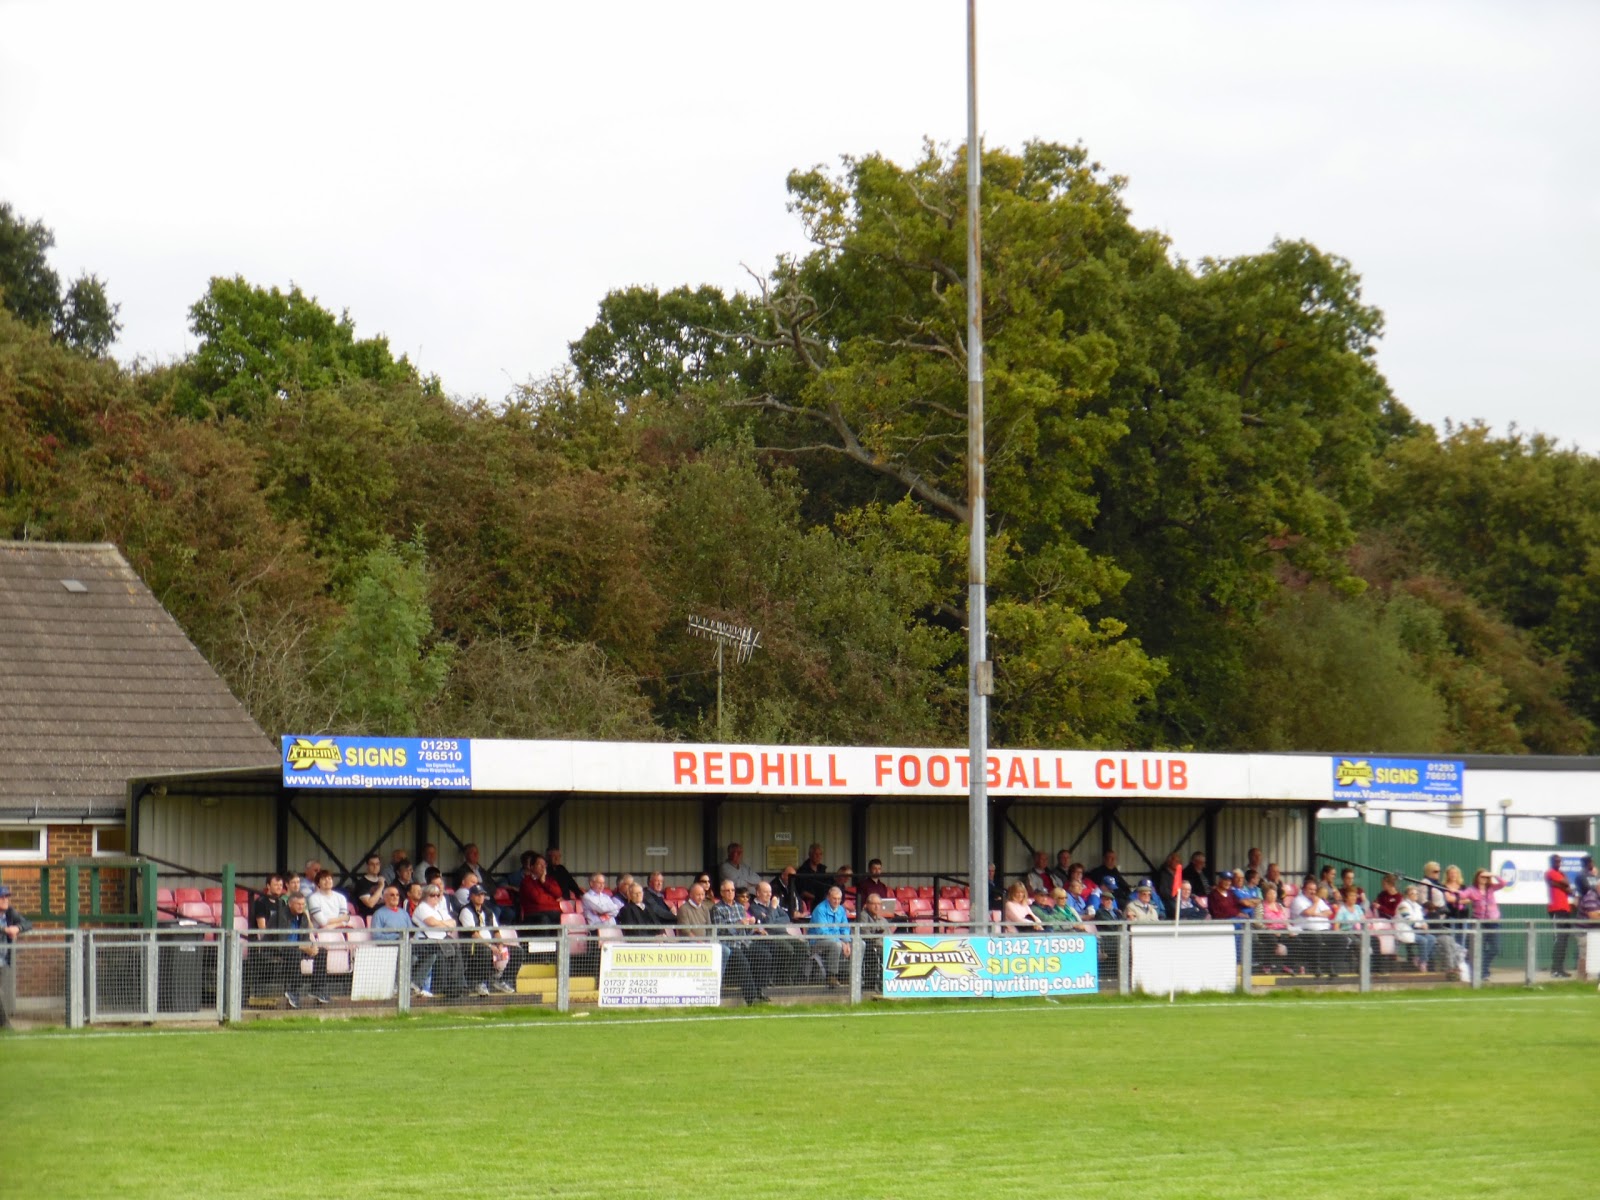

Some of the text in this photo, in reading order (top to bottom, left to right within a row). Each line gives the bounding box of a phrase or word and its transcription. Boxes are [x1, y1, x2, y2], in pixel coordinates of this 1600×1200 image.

[421, 740, 458, 750] 01293
[345, 747, 407, 767] SIGNS
[418, 751, 462, 761] 786510
[673, 751, 1188, 791] REDHILL FOOTBALL CLUB
[1375, 768, 1419, 784] SIGNS
[286, 774, 470, 788] www.VanSignwriting.co.uk
[987, 937, 1085, 955] 01342 715999
[616, 953, 709, 963] BAKER'S RADIO LTD.
[893, 949, 975, 967] XTREME
[986, 956, 1061, 975] SIGNS
[603, 979, 658, 987] 01737 242322
[885, 972, 1095, 996] www.VanSignwriting.co.uk
[603, 987, 658, 995] 01737 240543
[602, 996, 718, 1005] Your local Panasonic specialist
